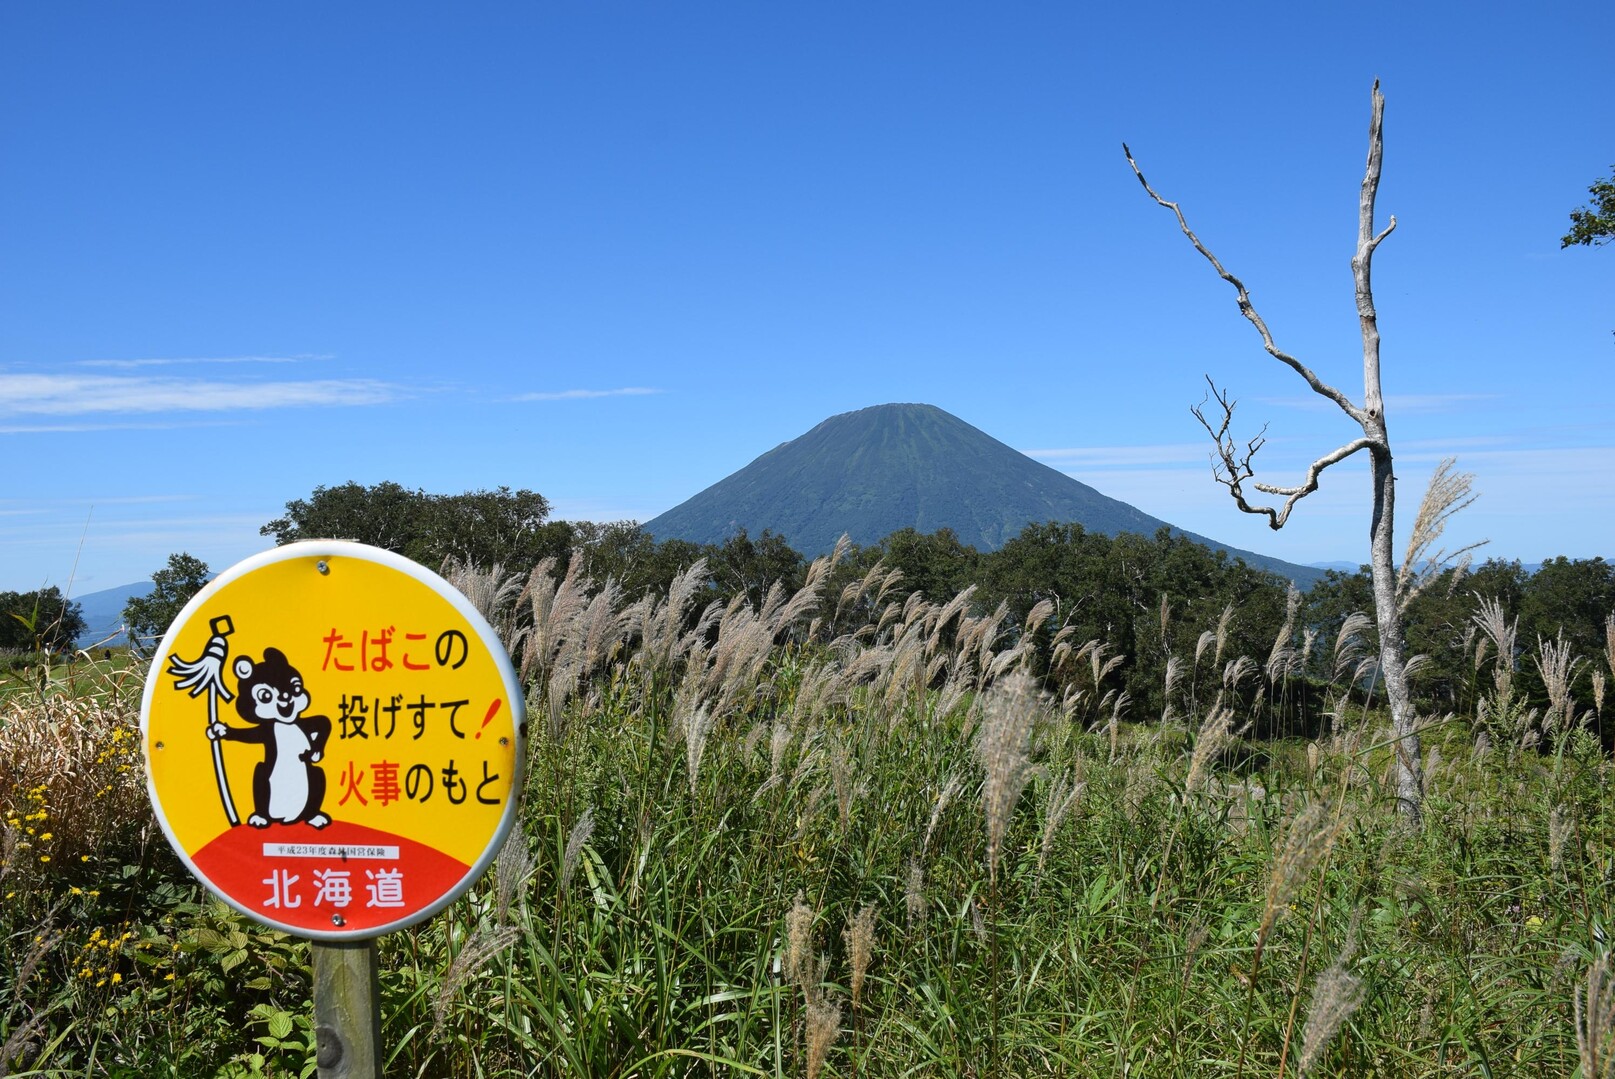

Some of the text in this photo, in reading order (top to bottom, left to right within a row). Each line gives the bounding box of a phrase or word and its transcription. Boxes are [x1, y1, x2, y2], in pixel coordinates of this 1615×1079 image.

[322, 625, 468, 672] たばこの
[338, 759, 501, 807] 火事のもと
[262, 867, 406, 909] 北海道
